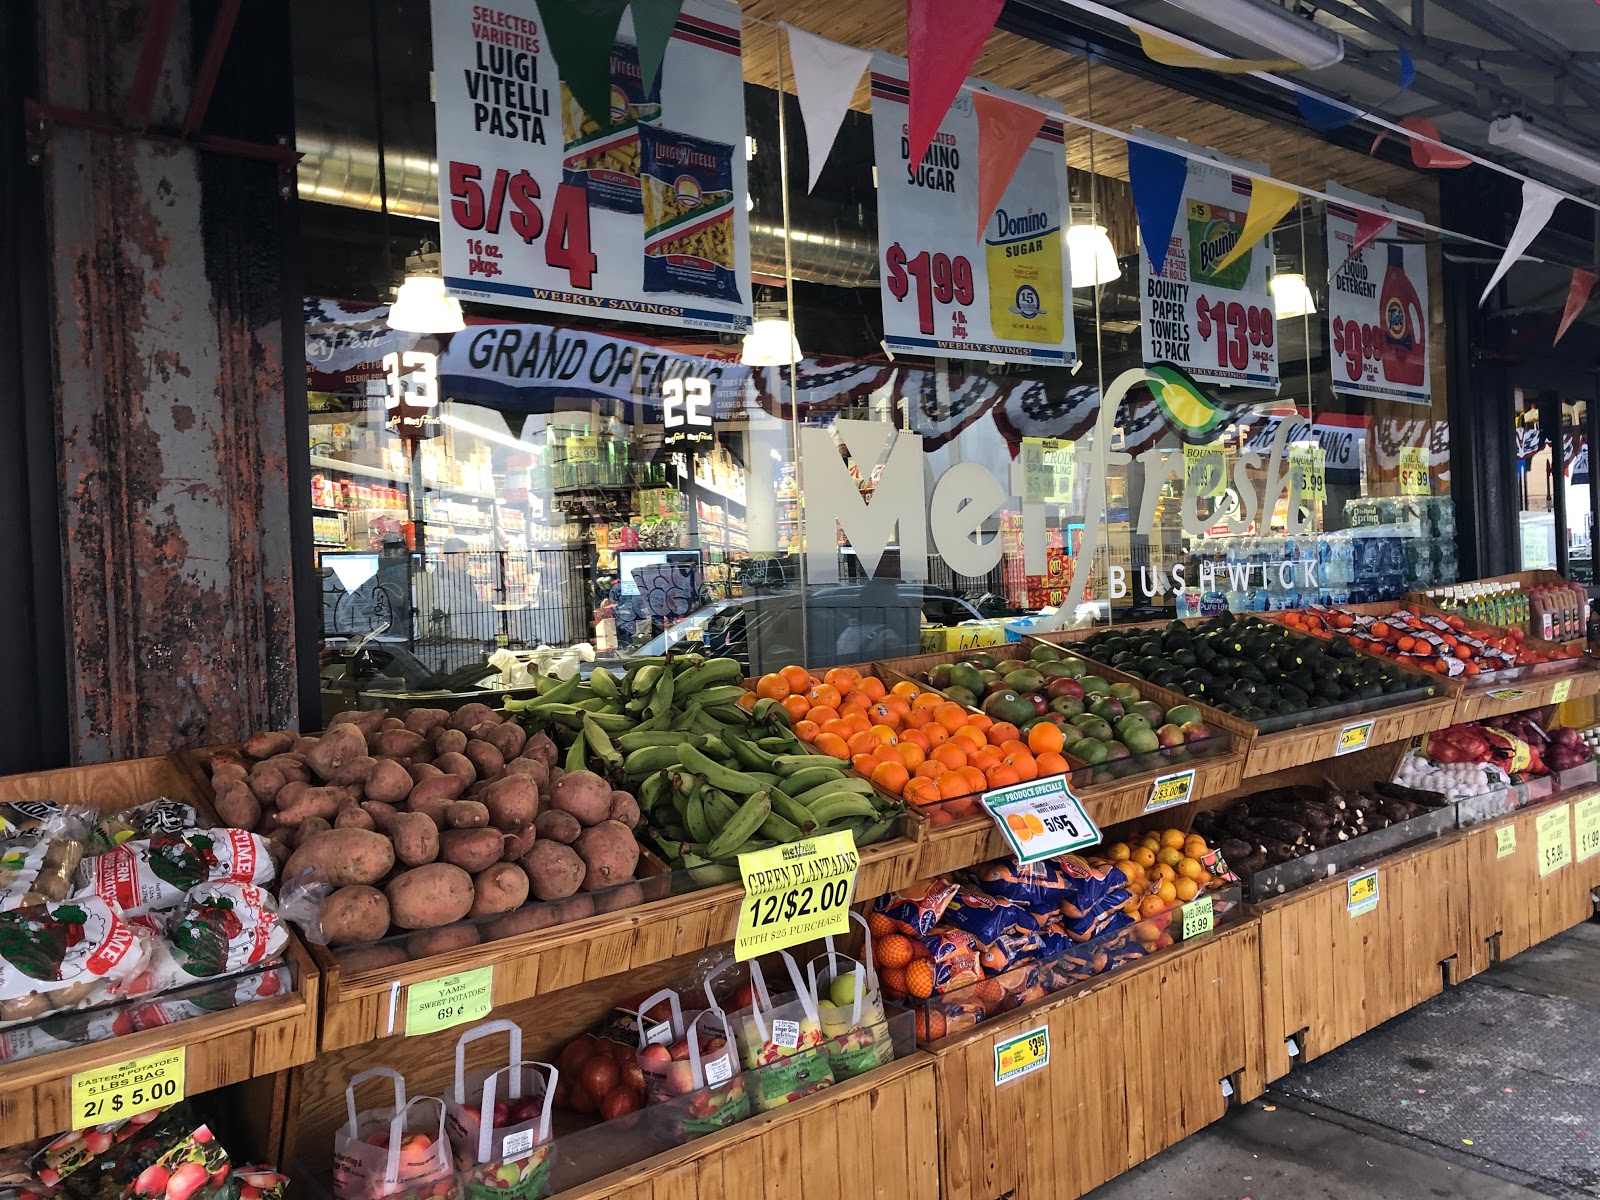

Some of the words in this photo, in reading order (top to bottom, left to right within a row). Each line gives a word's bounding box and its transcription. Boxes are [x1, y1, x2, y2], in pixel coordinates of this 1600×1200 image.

[472, 5, 538, 36] SELECTED
[471, 22, 540, 53] VARIETIES
[477, 42, 538, 84] LUIGI
[610, 56, 642, 79] VITELL
[464, 69, 549, 116] VITELLI
[474, 103, 546, 145] PASTA
[902, 123, 957, 147] GLATED
[901, 136, 959, 170] DMINO
[907, 164, 955, 193] SUGAR
[996, 207, 1048, 237] Domino
[467, 239, 482, 256] 16
[484, 243, 503, 258] oz.
[1005, 240, 1043, 257] SUGAR
[469, 257, 503, 277] pkgs.
[1169, 270, 1187, 281] ROLLS
[1344, 260, 1368, 280] LIQUID
[1020, 292, 1034, 304] 15
[1147, 278, 1190, 303] BOUNTY
[1336, 274, 1377, 299] DETERGENT
[532, 288, 604, 308] WEEKLY
[608, 298, 685, 317] SAVINGS!
[1152, 299, 1185, 323] PAPER
[952, 311, 957, 323] 4
[1149, 318, 1190, 342] TOWELS
[468, 326, 589, 379] GRAND
[937, 341, 984, 352] WEEKLY
[985, 344, 1031, 356] SAVINGS!
[1151, 340, 1163, 359] 12
[1164, 341, 1191, 362] PACK
[1215, 370, 1248, 380] SAVINGS!
[569, 449, 596, 460] $4.99
[1026, 450, 1040, 463] LA
[1043, 450, 1074, 465] CROIX
[1027, 465, 1072, 476] SPARKLING
[1026, 476, 1057, 492] $5.99
[1050, 558, 1062, 574] RITZ
[1109, 558, 1319, 600] BUSHWICK
[1051, 589, 1063, 605] RITZ
[1201, 603, 1217, 611] Pure
[1005, 788, 1035, 802] PRODUCE
[1034, 781, 1063, 796] SPECIALS
[1043, 814, 1079, 838] 5/$5
[748, 866, 792, 896] GREEN
[792, 851, 858, 886] PLANTAINS
[750, 879, 848, 928] 12/$2.00
[740, 932, 768, 948] WITH
[770, 927, 787, 941] $25
[789, 913, 843, 936] PURCHASE
[419, 999, 447, 1011] SWEET
[448, 986, 486, 1004] POTATOES
[439, 984, 466, 997] YAMS
[438, 1007, 453, 1020] 69
[78, 1072, 125, 1088] EASTERN
[127, 1056, 179, 1075] POTATOES
[88, 1087, 96, 1095] 5
[101, 1078, 129, 1092] LBS
[134, 1068, 166, 1083] BAG
